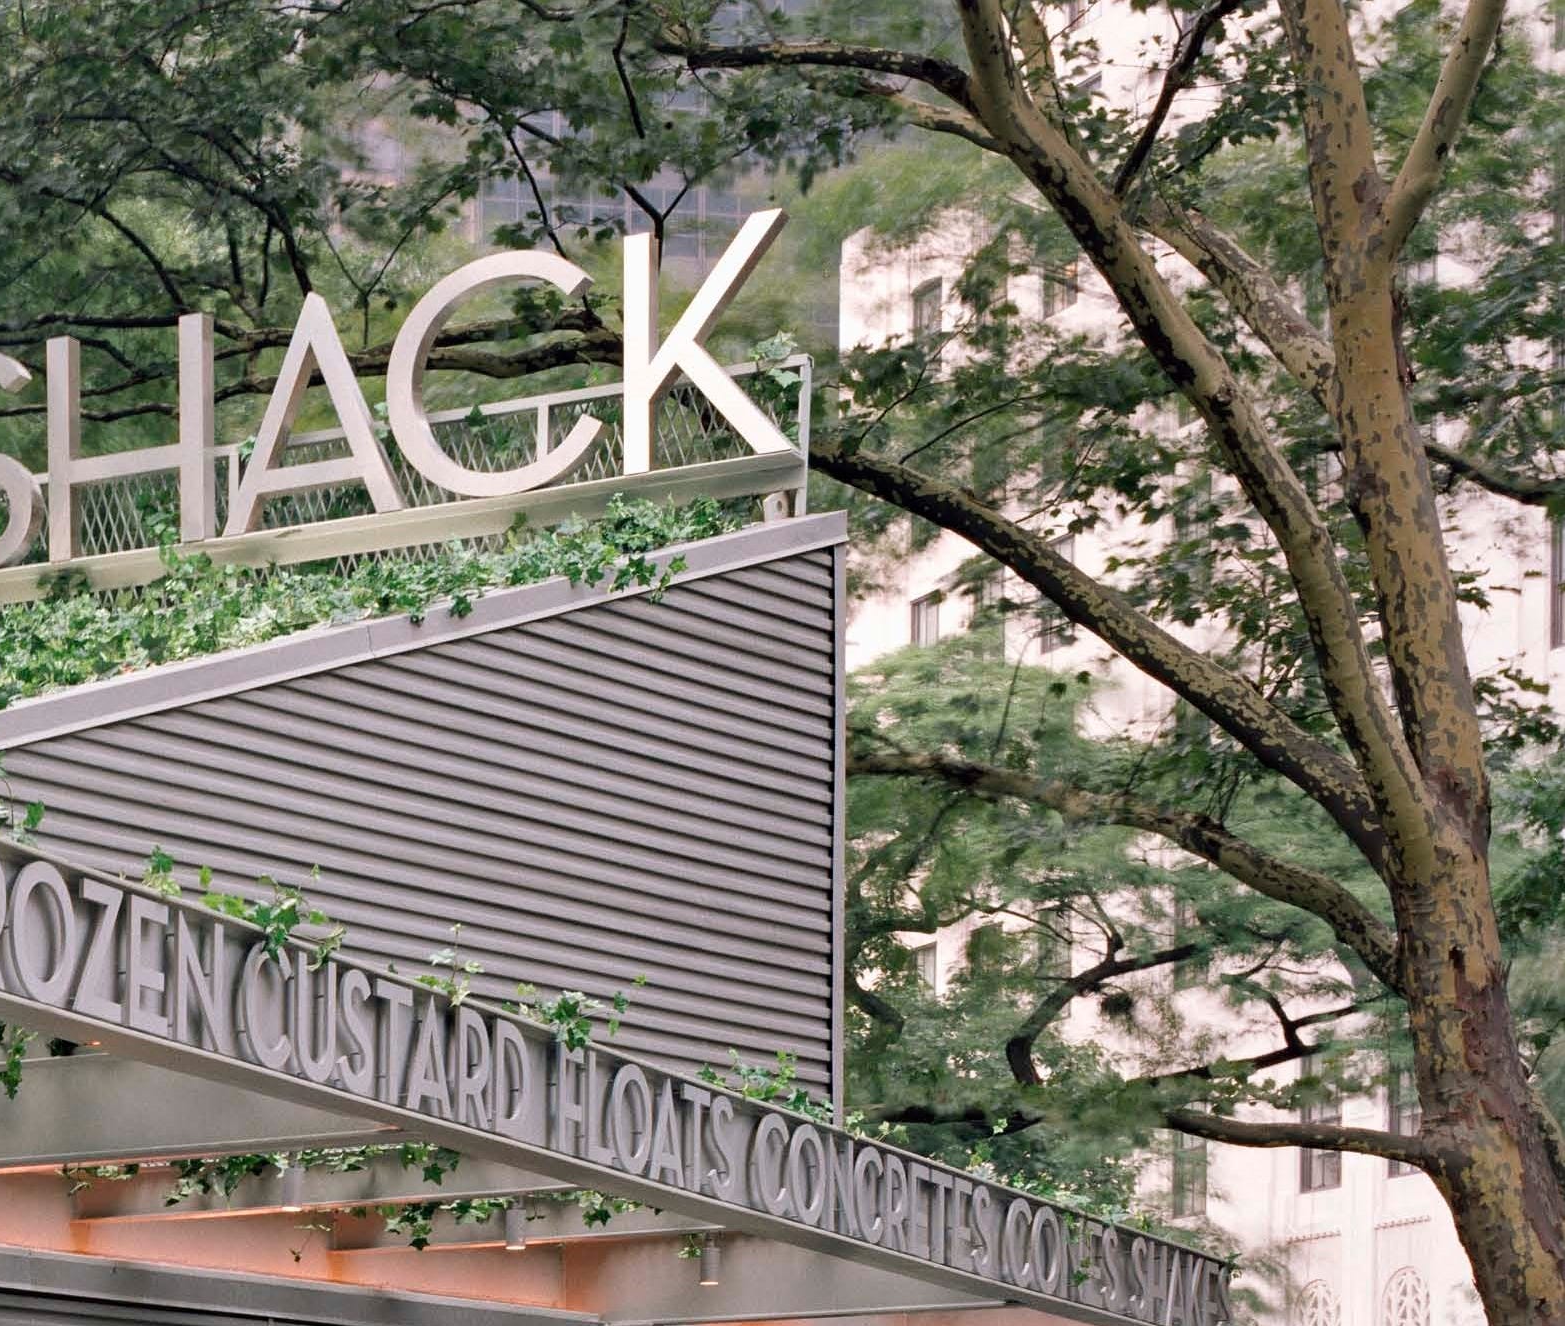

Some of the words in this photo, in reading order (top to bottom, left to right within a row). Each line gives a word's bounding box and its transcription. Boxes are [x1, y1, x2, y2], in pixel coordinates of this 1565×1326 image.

[242, 944, 531, 1130] CUSTARD
[558, 1042, 736, 1204] FLOATS
[753, 1114, 992, 1276] CONCRETES
